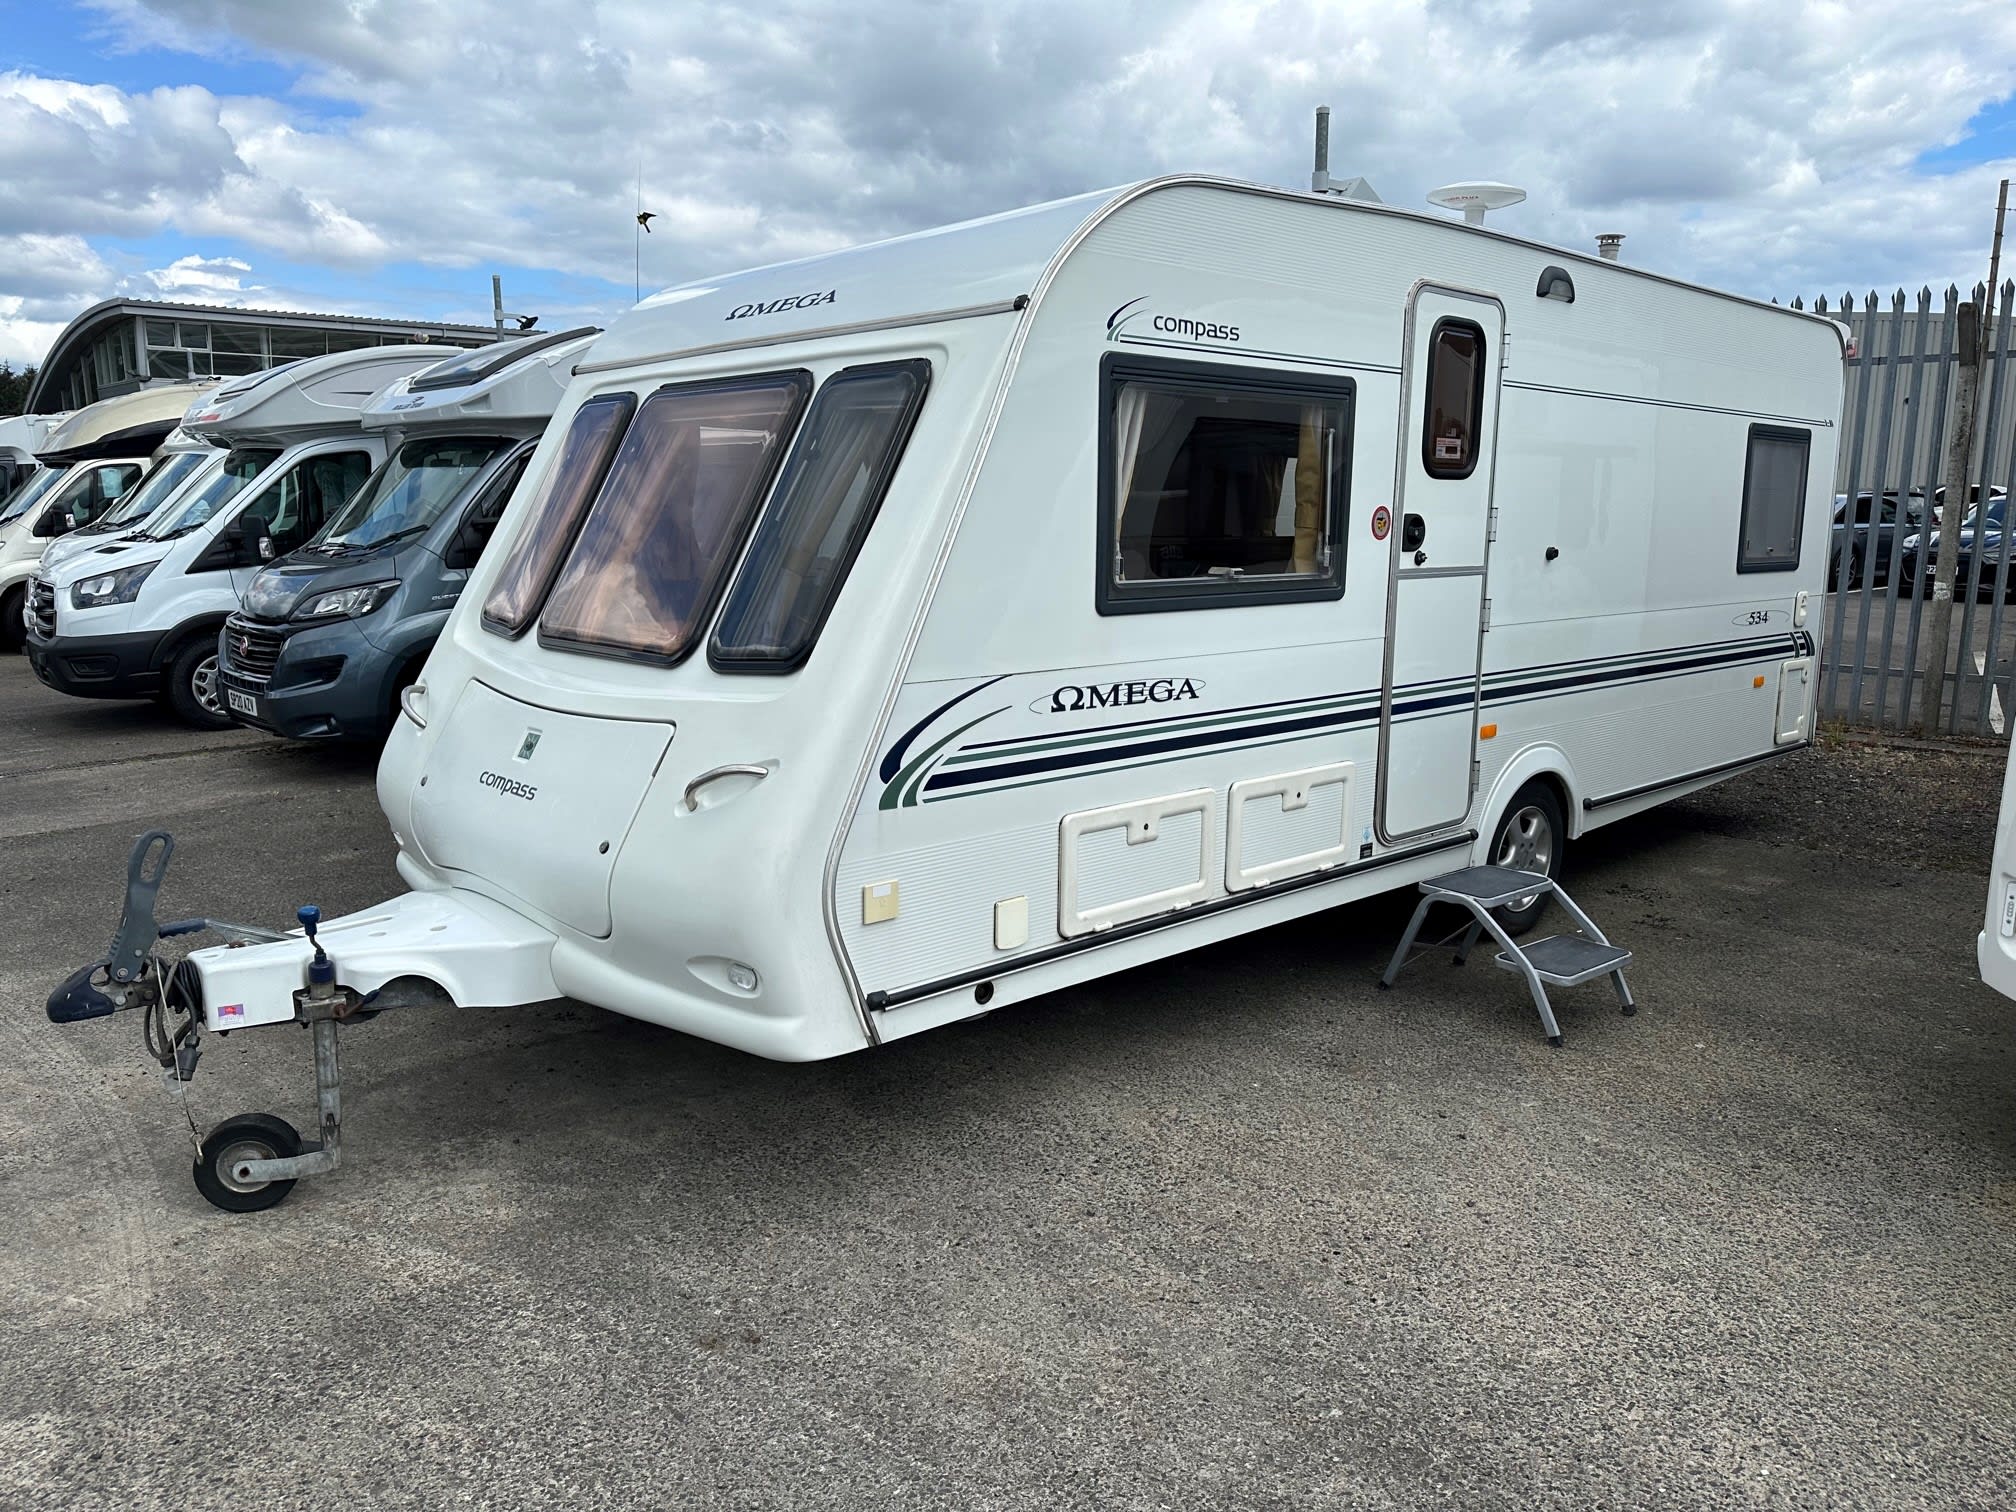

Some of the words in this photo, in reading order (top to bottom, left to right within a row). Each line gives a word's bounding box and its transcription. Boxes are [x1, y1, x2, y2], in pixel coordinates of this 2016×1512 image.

[1154, 315, 1240, 342] compass
[1748, 610, 1769, 625] 534
[479, 770, 538, 801] compass
